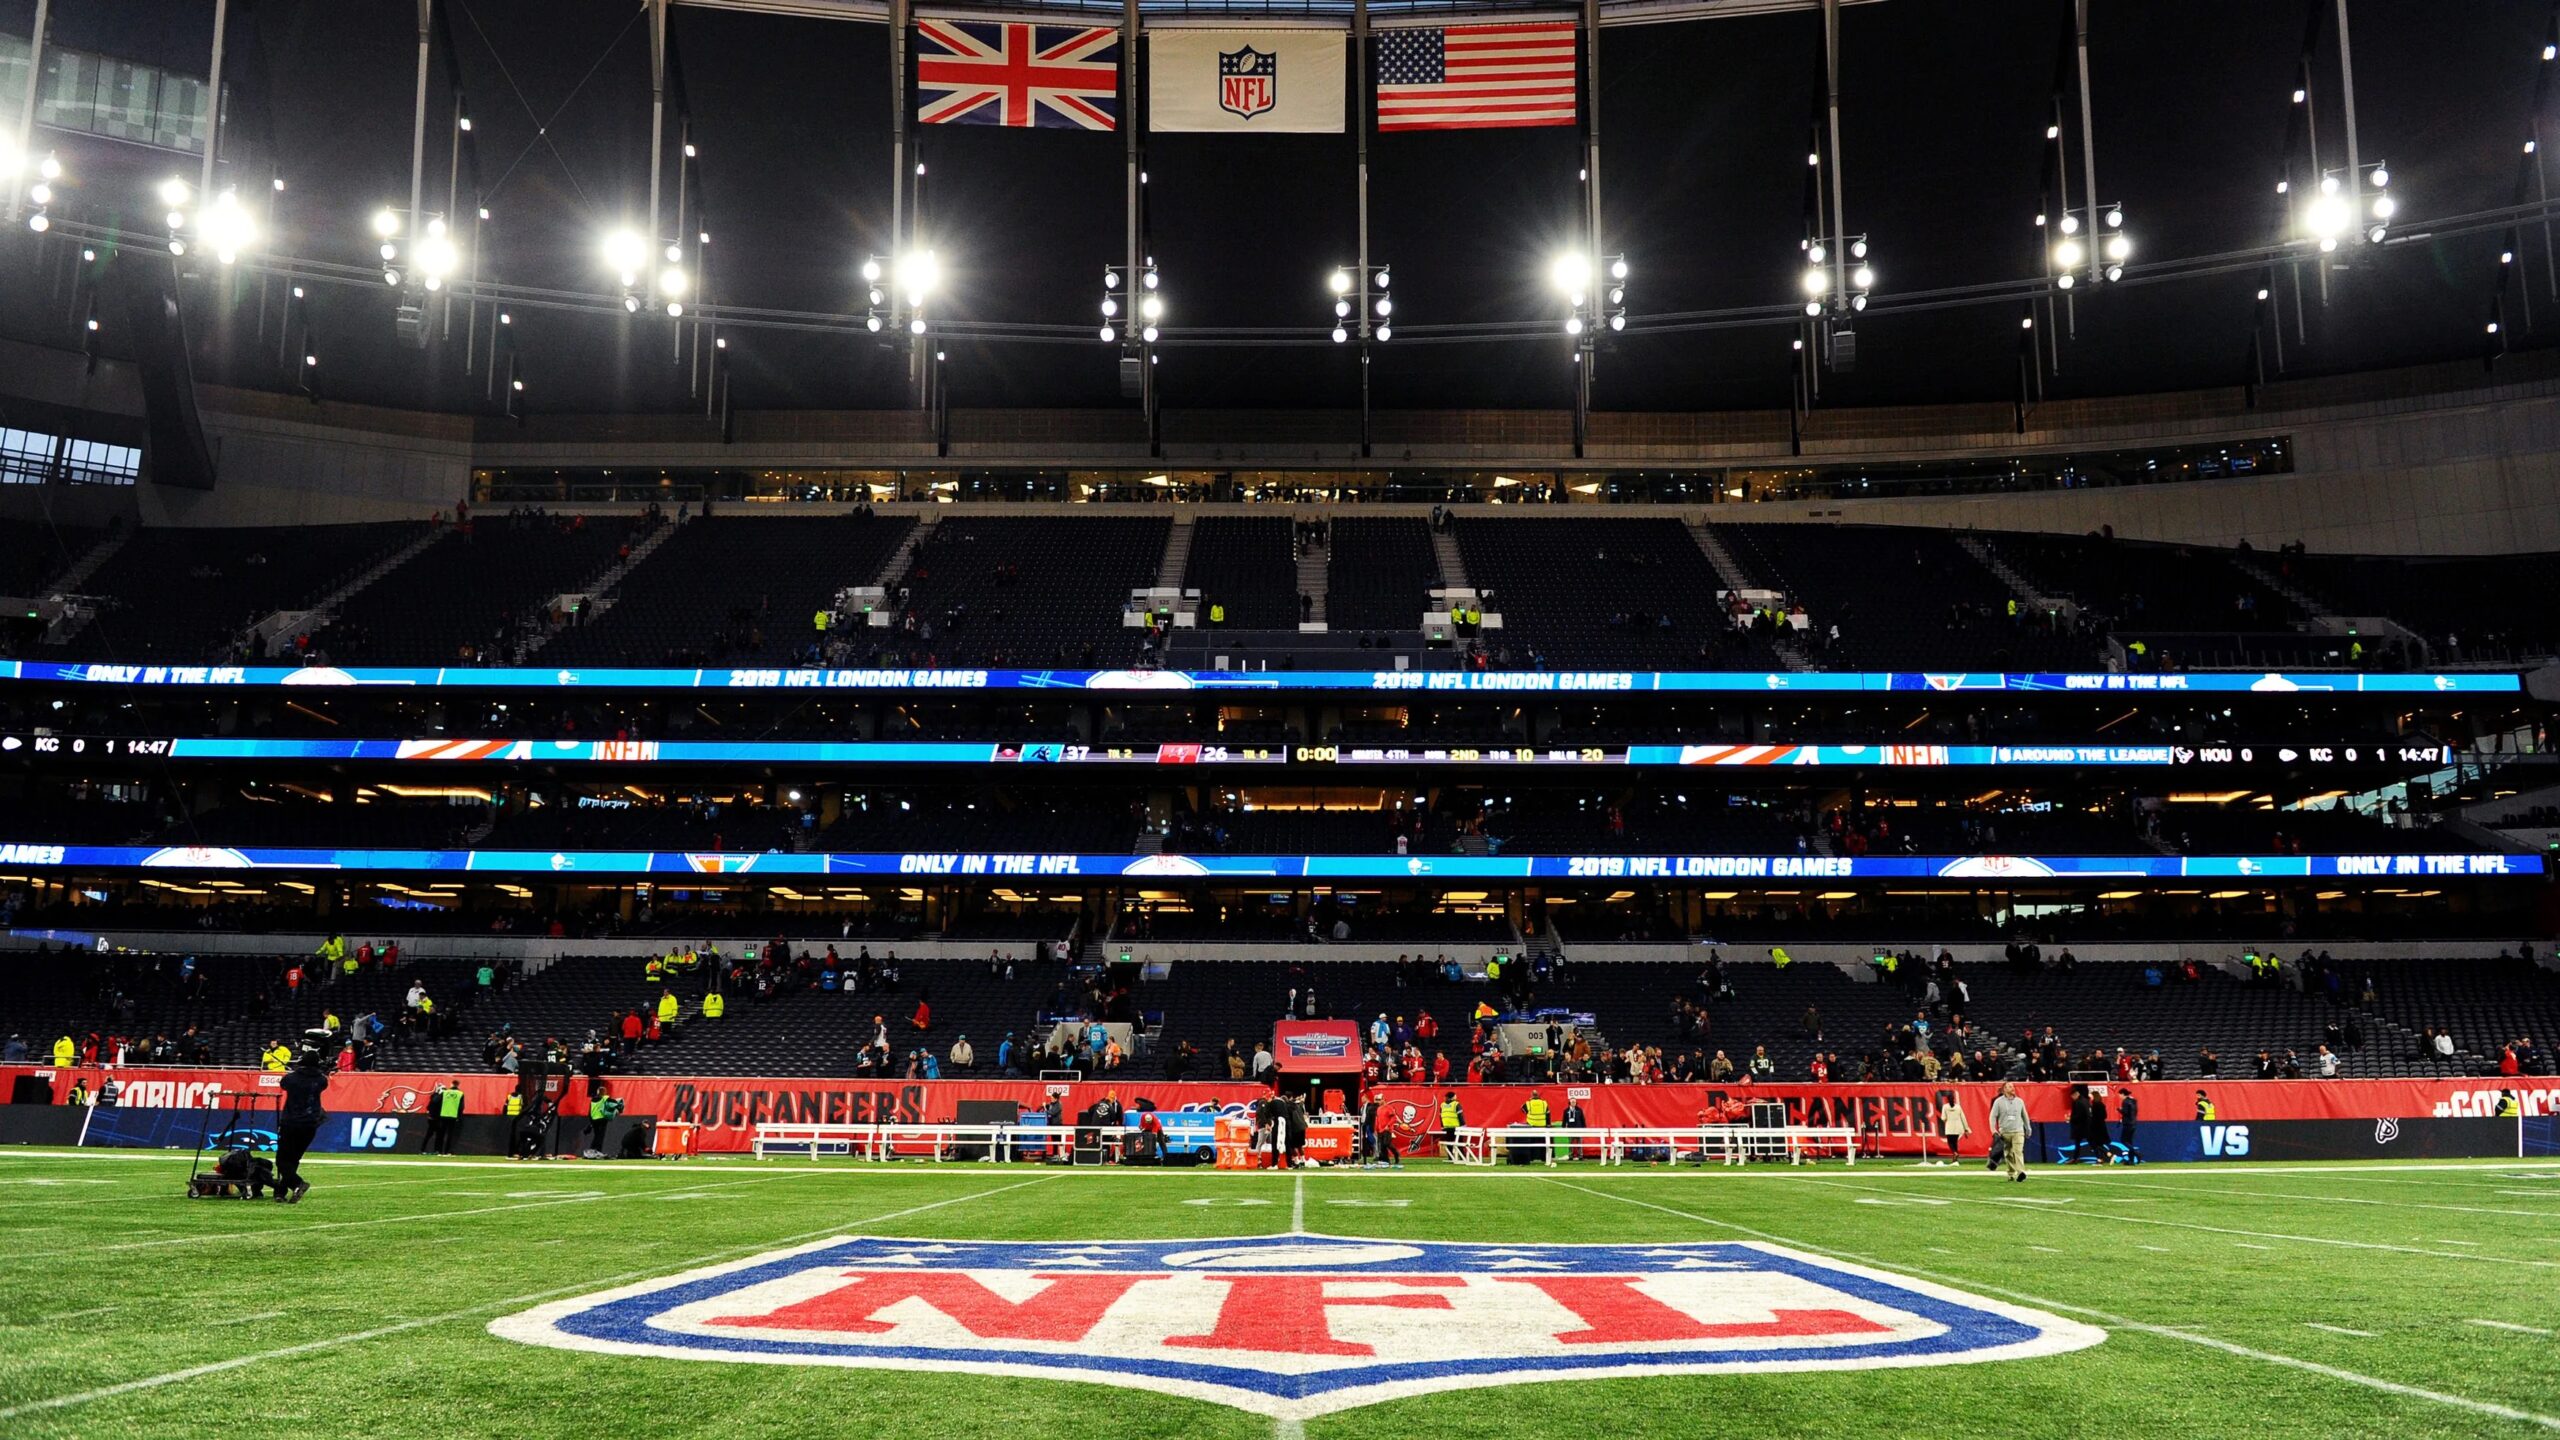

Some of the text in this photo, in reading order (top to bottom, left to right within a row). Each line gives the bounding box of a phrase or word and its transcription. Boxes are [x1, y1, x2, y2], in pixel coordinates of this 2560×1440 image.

[1224, 78, 1271, 112] NFL
[86, 664, 245, 684] ONLY IN THE NFL
[729, 670, 987, 687] 2019 NFL LONDON GAMES
[1372, 672, 1633, 690] 2019 NFL LONDON GAMES
[2065, 675, 2188, 689] ONLY IN THE NFL
[35, 738, 168, 754] KC 0 1 14:47
[1066, 745, 1090, 760] 37
[1123, 749, 1132, 759] 2
[1203, 746, 1228, 761] 26
[1260, 750, 1268, 759] 0
[1296, 747, 1336, 761] 0:00
[1386, 750, 1409, 760] 4TH
[1450, 750, 1479, 760] 2ND
[1515, 748, 1534, 761] 10
[1581, 748, 1604, 761] 20
[2012, 749, 2168, 762] AROUND THE LEAGUE
[2199, 748, 2253, 762] HOU 0
[2309, 748, 2438, 762] KC 0 1 14:47
[0, 845, 64, 864] AMES
[899, 854, 1080, 874] ONLY IN THE NFL
[1568, 857, 1853, 876] 2019 NFL LONDON GAMES
[2337, 855, 2509, 875] ONLY IN THE NFL
[758, 982, 766, 990] 12
[1368, 1066, 1379, 1077] 55
[1757, 1059, 1769, 1069] 30
[1569, 1088, 1589, 1096] E003
[673, 1084, 927, 1134] BUCCANEERS
[1705, 1089, 1959, 1142] BCANEERS
[350, 1117, 400, 1148] VS
[2200, 1125, 2249, 1156] VS
[700, 1271, 1892, 1357] NFL
